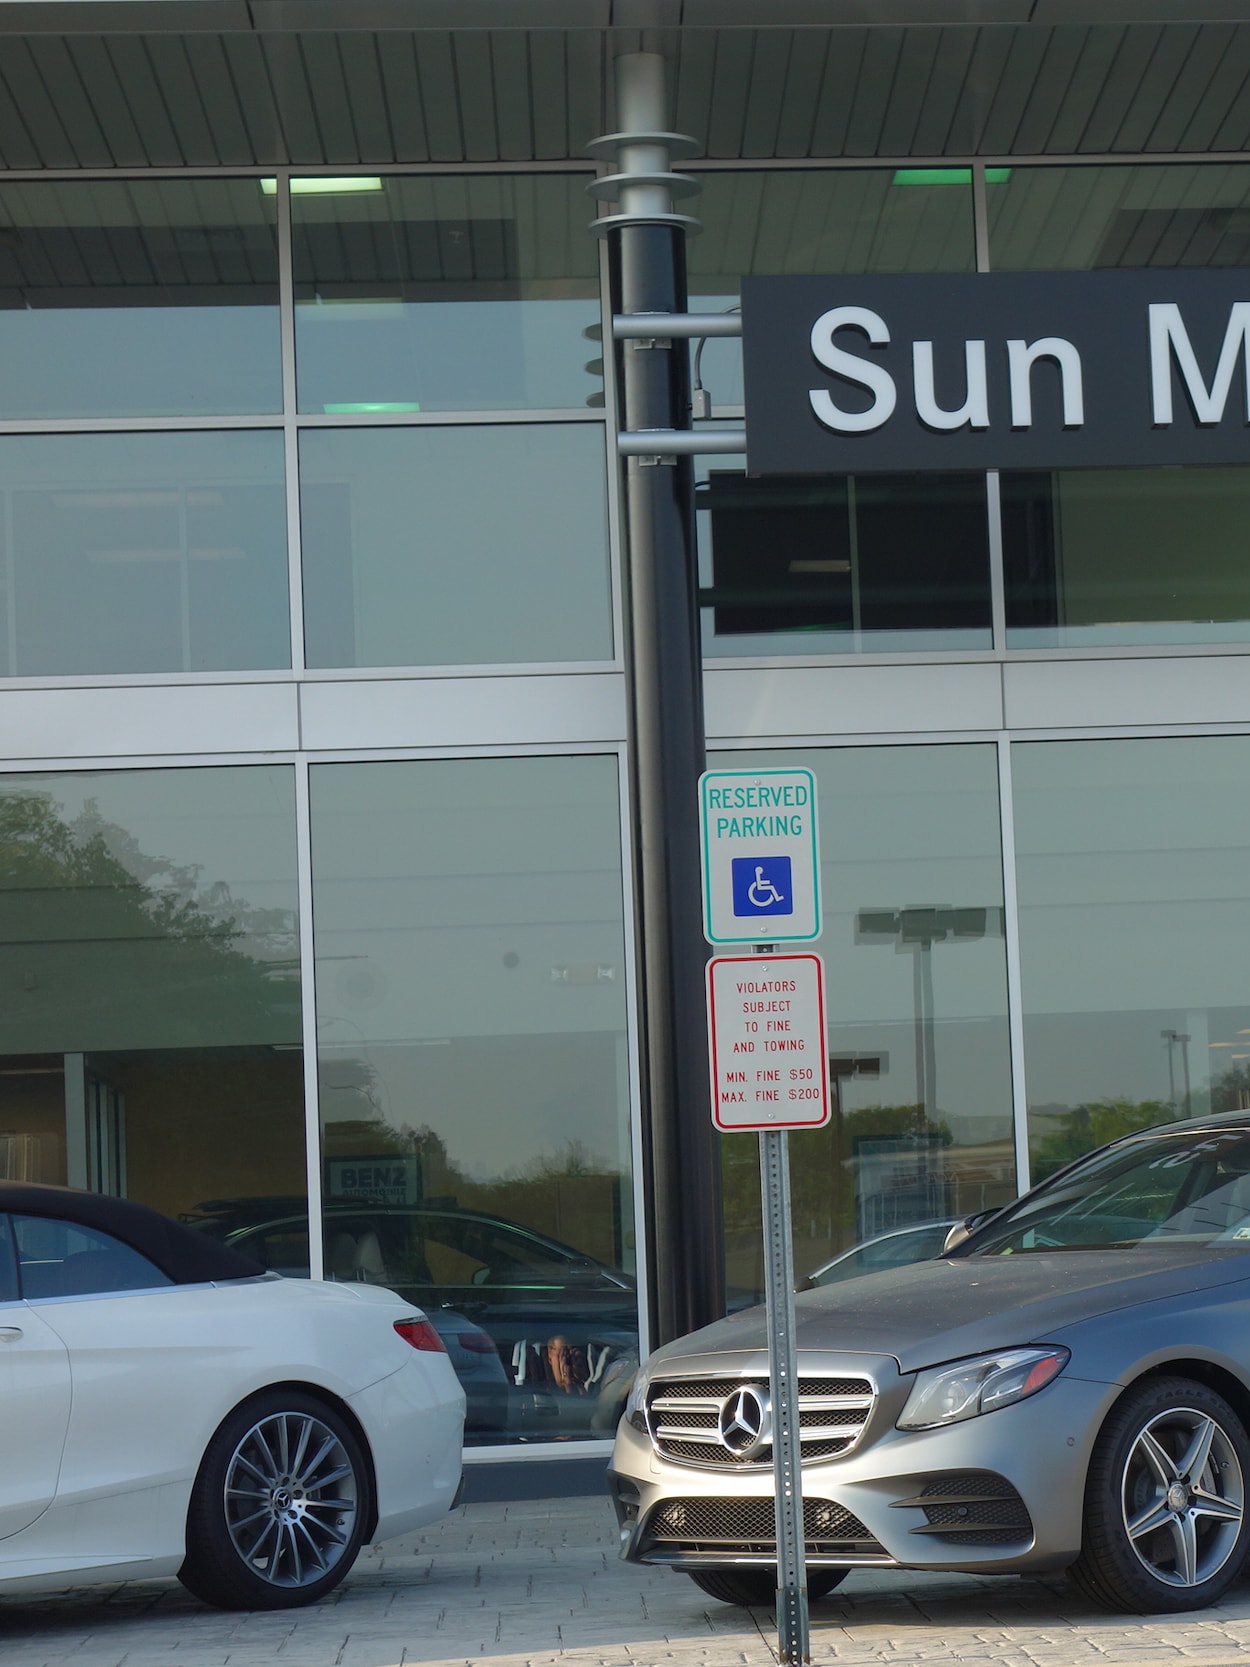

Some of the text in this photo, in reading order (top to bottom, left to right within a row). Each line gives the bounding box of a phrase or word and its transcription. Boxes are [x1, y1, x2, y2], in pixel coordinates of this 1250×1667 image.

[809, 305, 1084, 433] Sun
[708, 785, 809, 809] RESERVED
[716, 814, 803, 839] PARKING
[736, 981, 797, 993] VIOLATORS
[743, 1001, 792, 1013] SUBJECT
[745, 1021, 791, 1033] TO FINE
[733, 1040, 805, 1053] AND TOWING
[727, 1068, 813, 1082] MIN. FINE $50
[722, 1088, 819, 1103] MAX. FINE $200
[341, 1167, 407, 1188] BENZ
